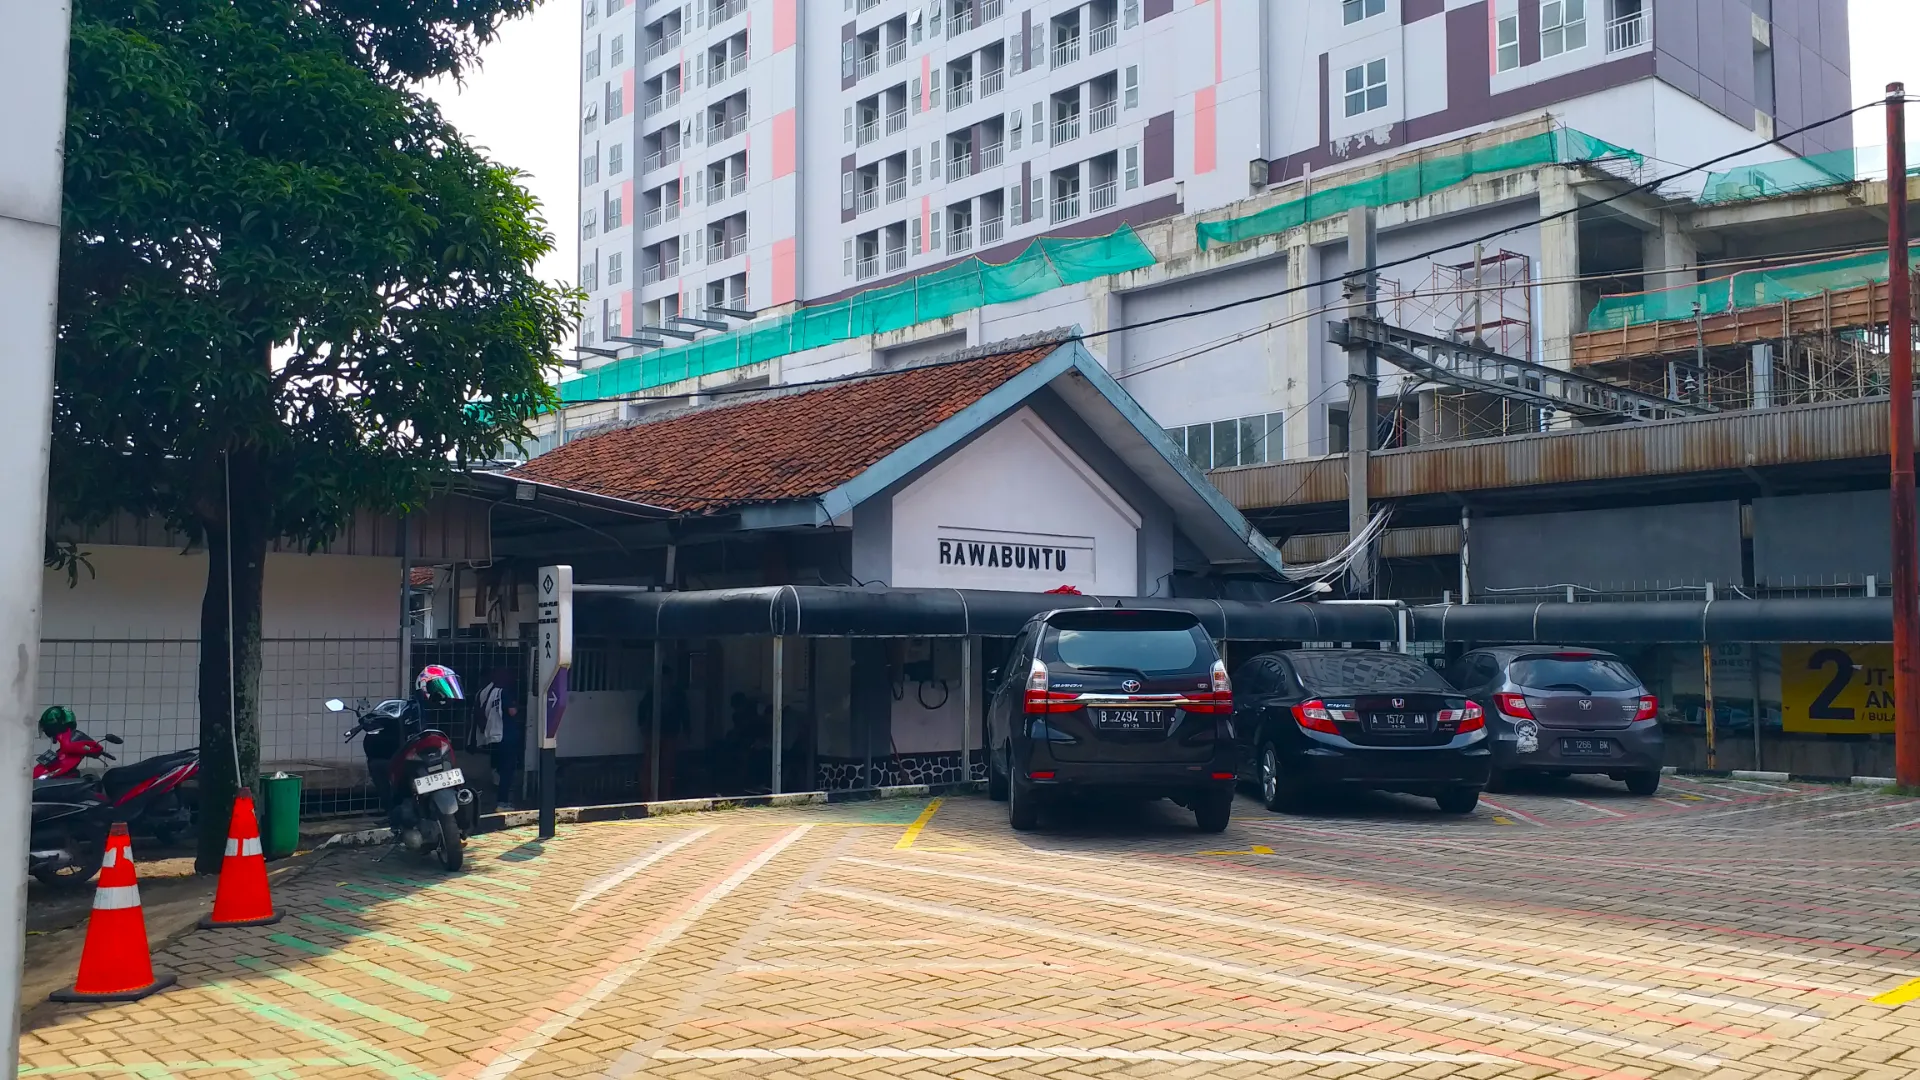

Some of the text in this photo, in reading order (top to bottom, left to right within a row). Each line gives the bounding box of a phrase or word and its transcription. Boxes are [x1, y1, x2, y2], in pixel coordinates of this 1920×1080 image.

[939, 541, 1067, 572] RAWABUNTU
[1808, 648, 1855, 720] 2
[1101, 711, 1161, 722] B 2494 TIY
[1372, 714, 1378, 724] A
[1386, 714, 1405, 724] 1572
